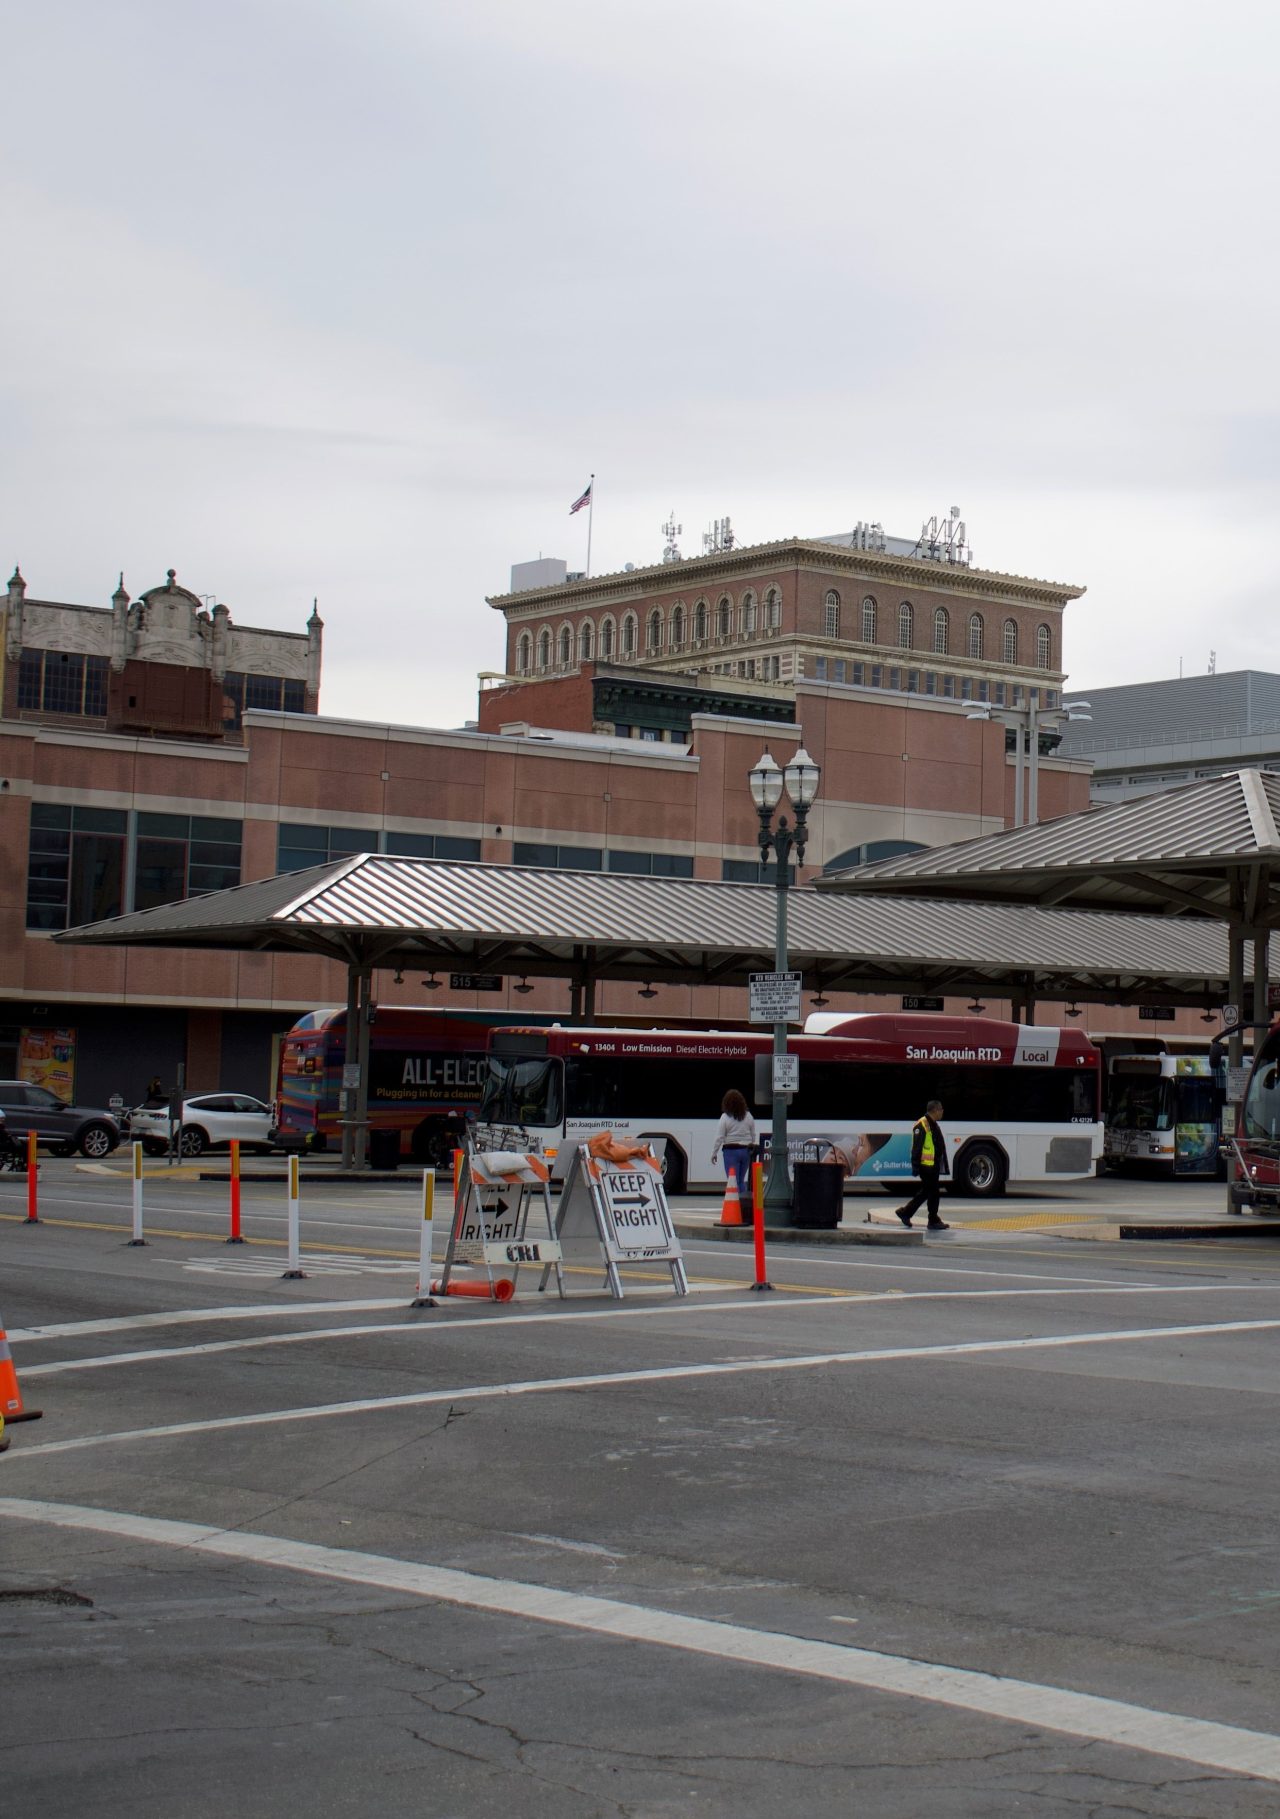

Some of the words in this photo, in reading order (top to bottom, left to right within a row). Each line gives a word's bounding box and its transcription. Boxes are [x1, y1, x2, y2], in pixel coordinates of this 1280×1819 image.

[452, 976, 472, 988] 515
[594, 1043, 616, 1052] 13404
[622, 1043, 638, 1052] Low
[638, 1044, 672, 1053] Emission
[676, 1044, 698, 1054] Diesel
[698, 1044, 723, 1054] Electric
[724, 1045, 747, 1056] Hybrid
[906, 1045, 928, 1060] San
[930, 1046, 976, 1063] Joaquin
[978, 1047, 1002, 1061] RTD
[1022, 1050, 1049, 1062] Local
[376, 1087, 417, 1099] Plugging
[419, 1088, 428, 1098] in
[429, 1088, 442, 1098] for
[442, 1089, 450, 1098] a
[566, 1121, 578, 1129] San
[578, 1121, 600, 1130] Joaquin
[601, 1121, 613, 1129] RTD
[614, 1121, 629, 1129] Local
[883, 1161, 900, 1169] Sutter
[609, 1175, 646, 1193] KEEP
[614, 1208, 659, 1228] RIGHT
[466, 1223, 513, 1240] RIGHT
